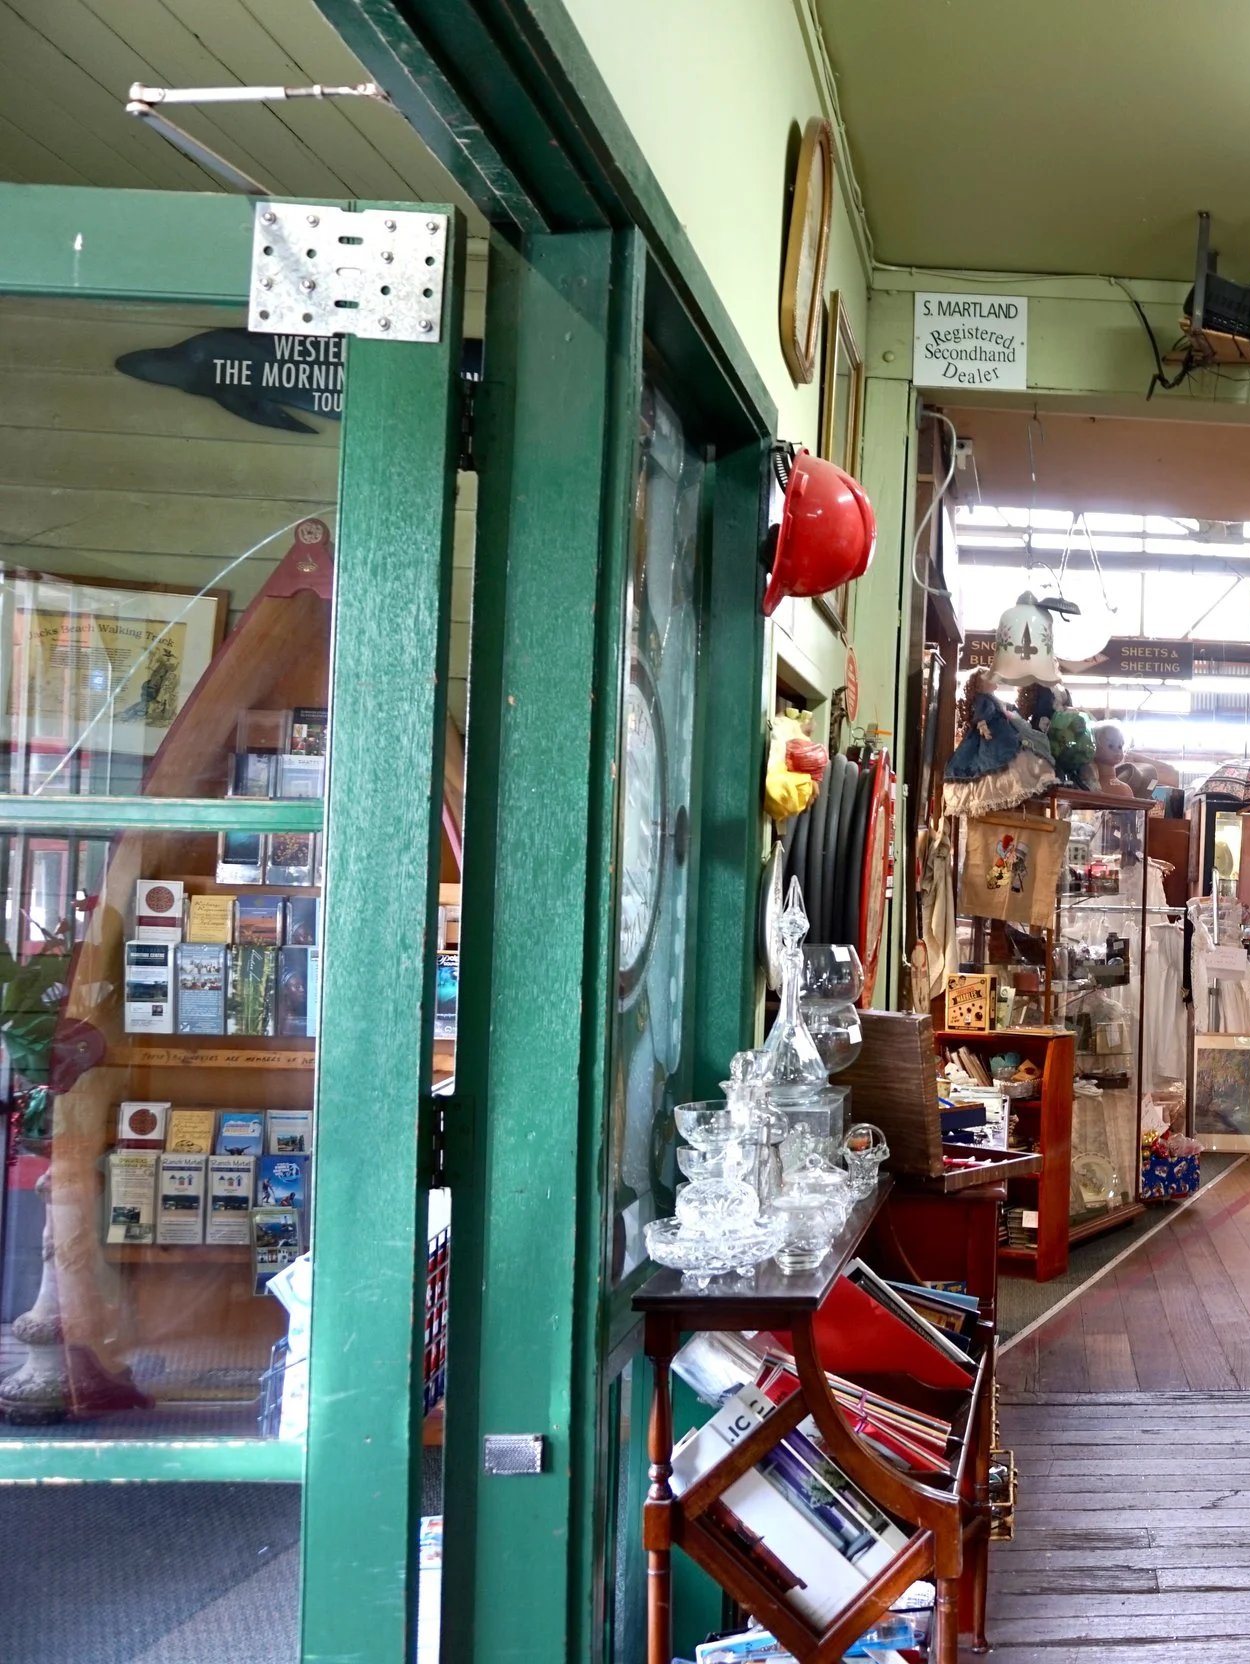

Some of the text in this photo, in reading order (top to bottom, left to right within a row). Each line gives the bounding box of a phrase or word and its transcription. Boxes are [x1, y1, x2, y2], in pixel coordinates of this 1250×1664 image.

[923, 300, 1018, 319] S. MARTLAND
[930, 323, 1015, 350] Registered
[925, 343, 1016, 363] Secondhand
[213, 359, 252, 386] THE
[942, 362, 1000, 384] Dealer
[61, 624, 95, 634] Beach
[98, 624, 143, 639] Walking
[1121, 646, 1168, 658] SHEETS
[1120, 661, 1180, 673] SHEETING
